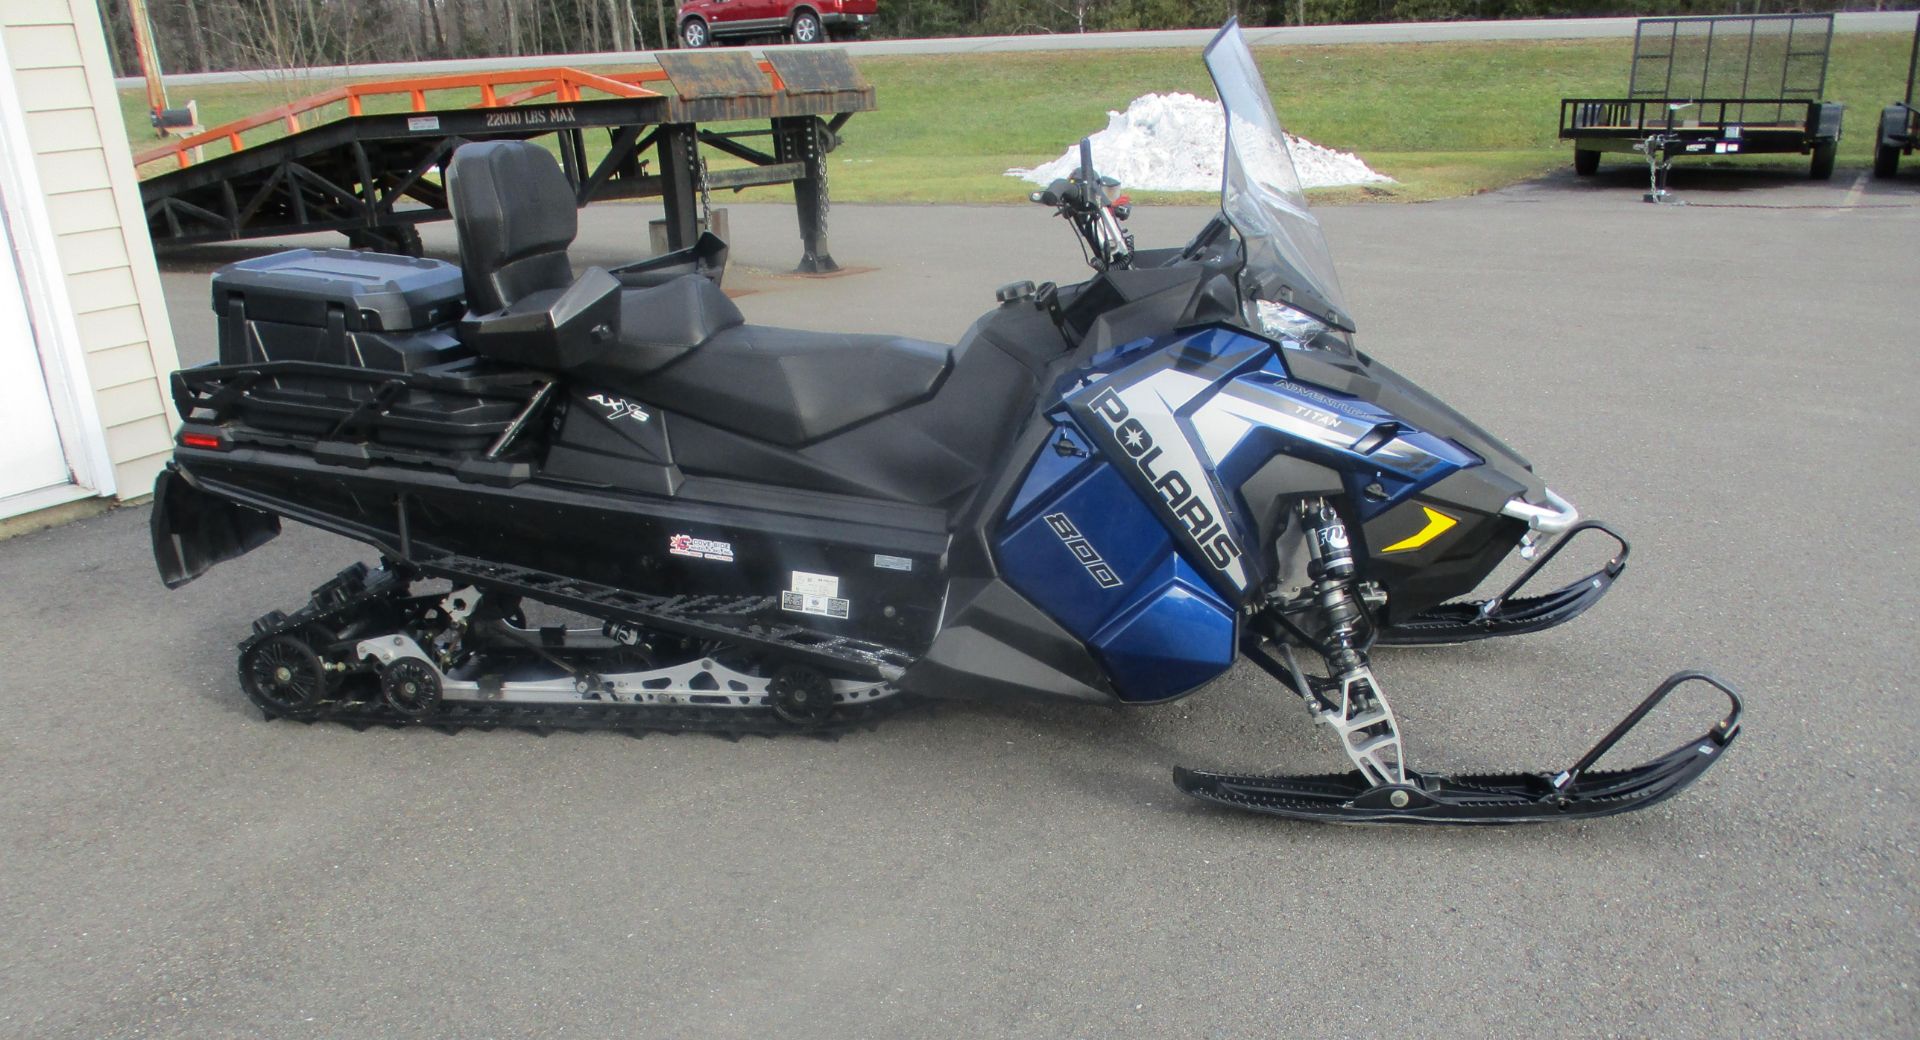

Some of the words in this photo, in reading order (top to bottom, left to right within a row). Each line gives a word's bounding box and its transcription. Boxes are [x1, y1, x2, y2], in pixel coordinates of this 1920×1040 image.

[486, 113, 522, 127] 22000
[525, 110, 547, 125] LBS
[550, 108, 576, 122] MAX
[1295, 405, 1342, 428] TITAN
[1088, 386, 1242, 570] POLARIS
[1043, 512, 1124, 588] 800
